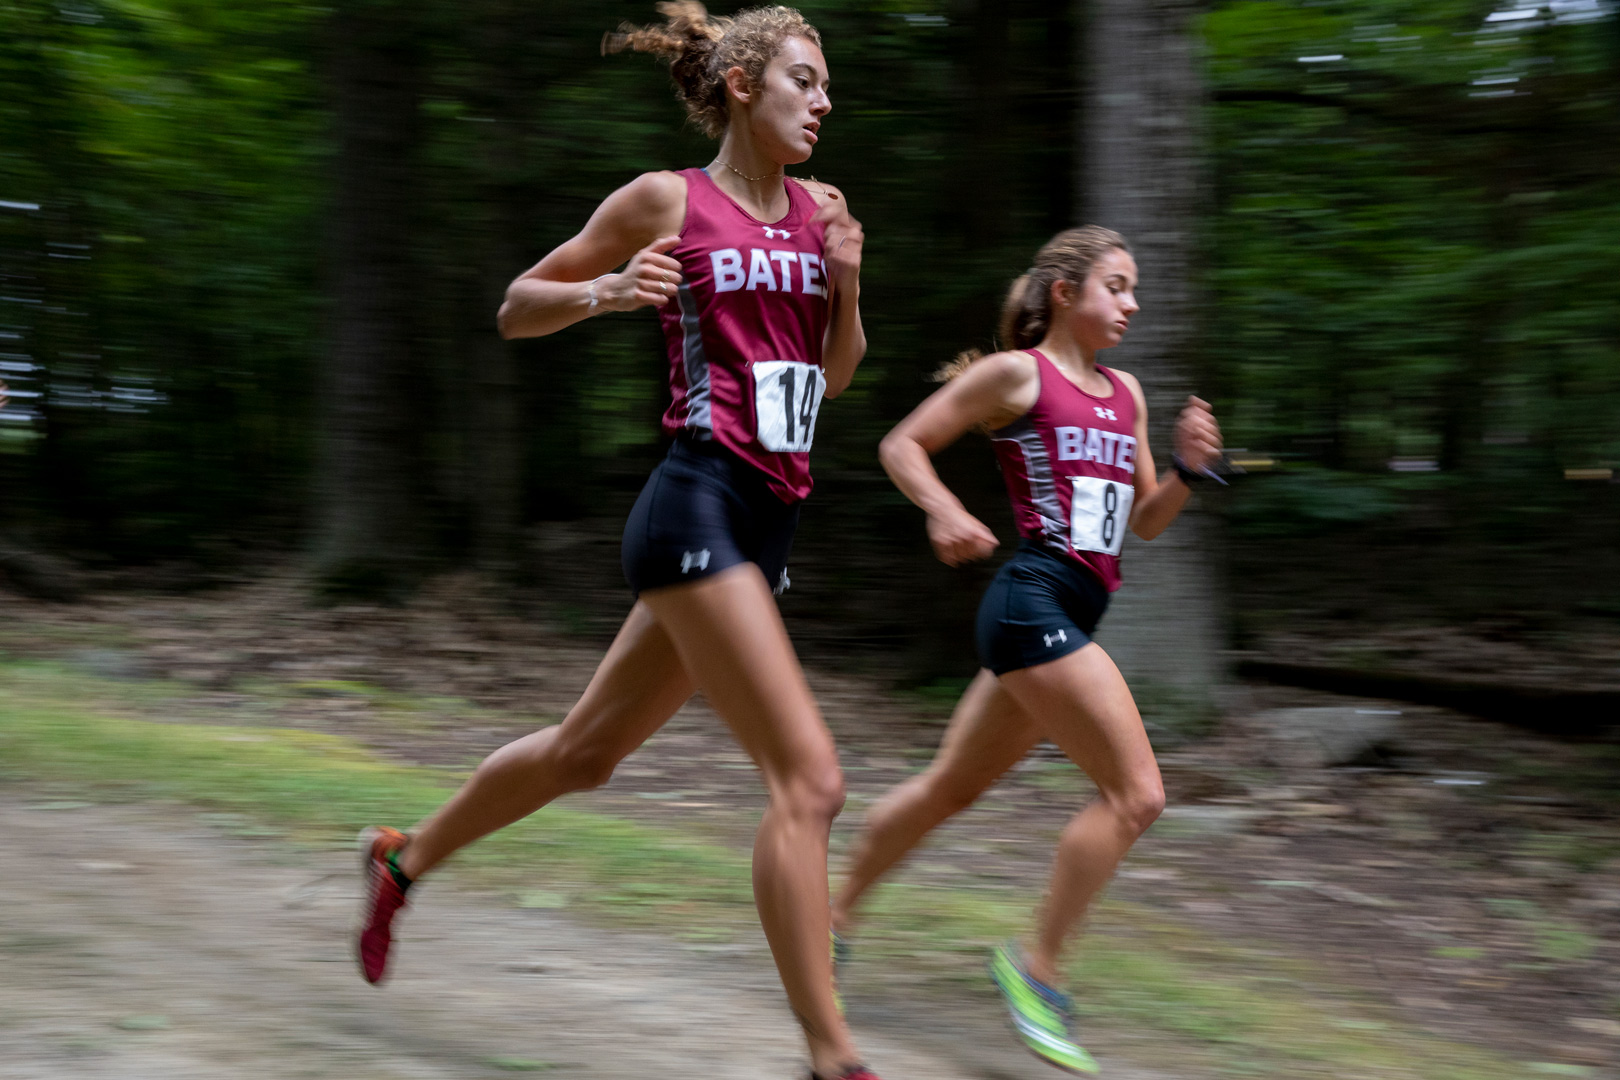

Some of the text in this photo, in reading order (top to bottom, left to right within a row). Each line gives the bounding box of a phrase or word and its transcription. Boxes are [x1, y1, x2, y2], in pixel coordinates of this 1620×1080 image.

[779, 367, 816, 444] 14
[1054, 426, 1137, 474] BATE
[1103, 482, 1117, 548] 8
